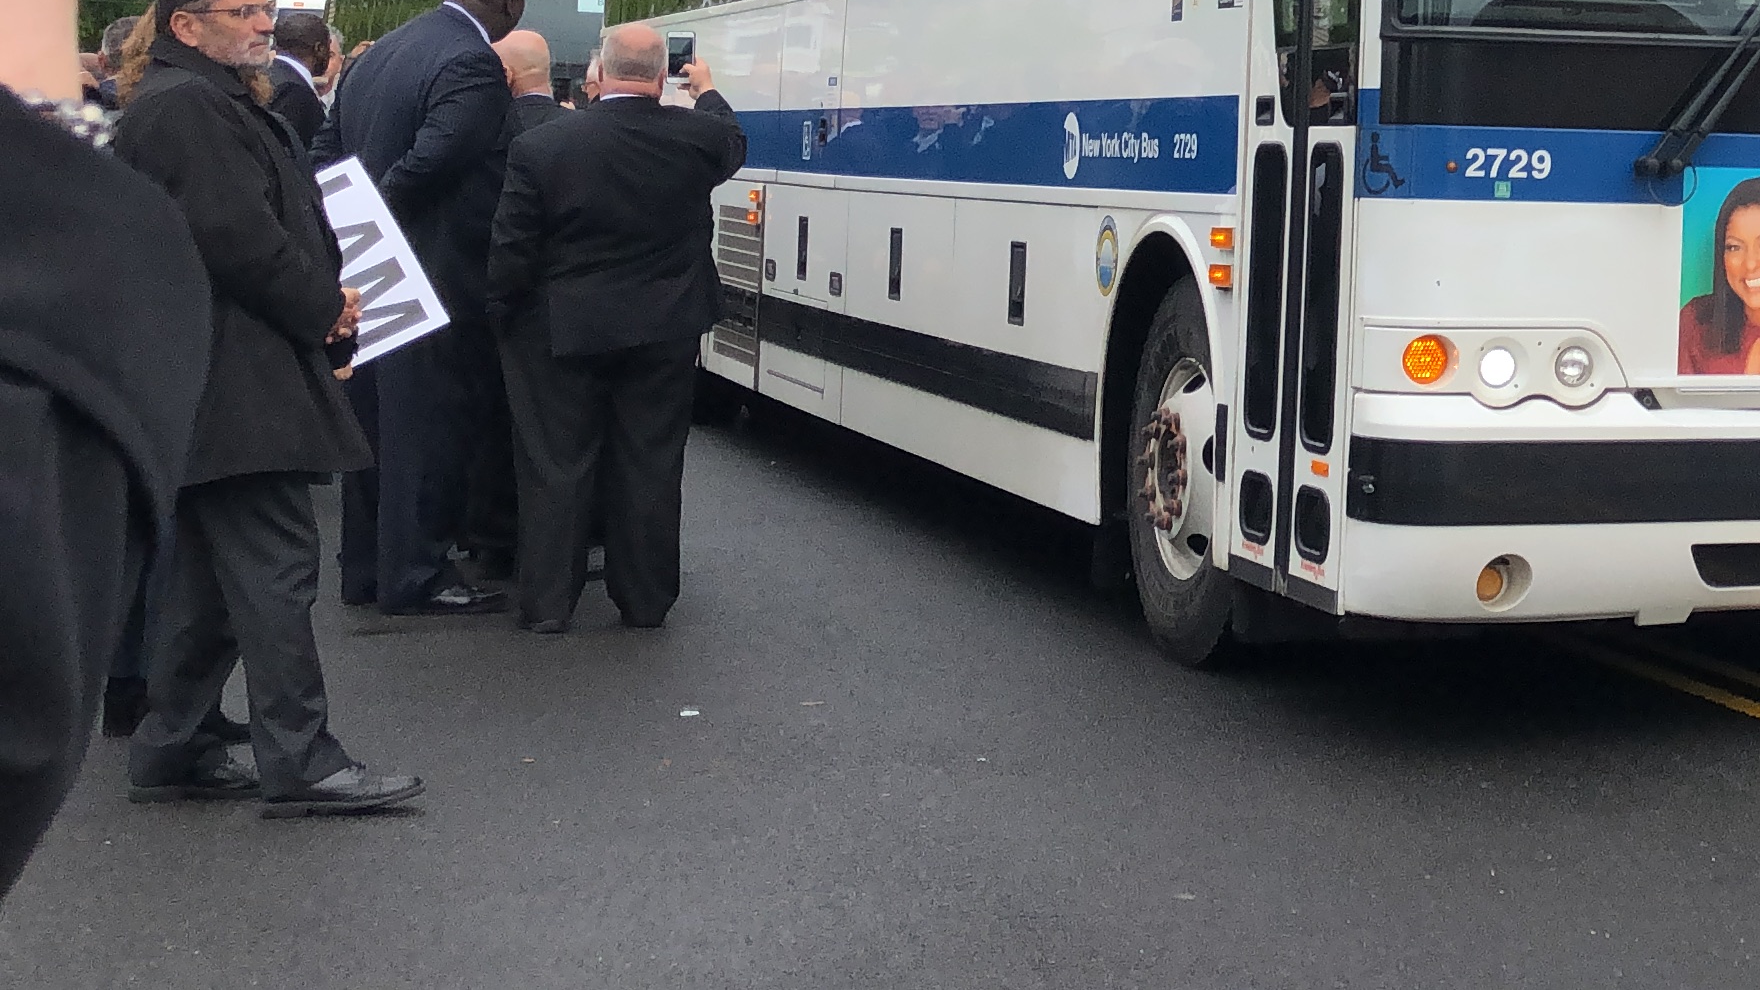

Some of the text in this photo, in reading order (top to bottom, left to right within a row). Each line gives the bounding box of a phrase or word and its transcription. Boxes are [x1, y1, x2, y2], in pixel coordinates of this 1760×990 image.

[1082, 132, 1100, 157] New
[1101, 132, 1121, 158] York
[1121, 131, 1140, 163] City
[1141, 132, 1159, 159] Bus
[1173, 133, 1198, 159] 2729
[1465, 147, 1552, 179] 2729
